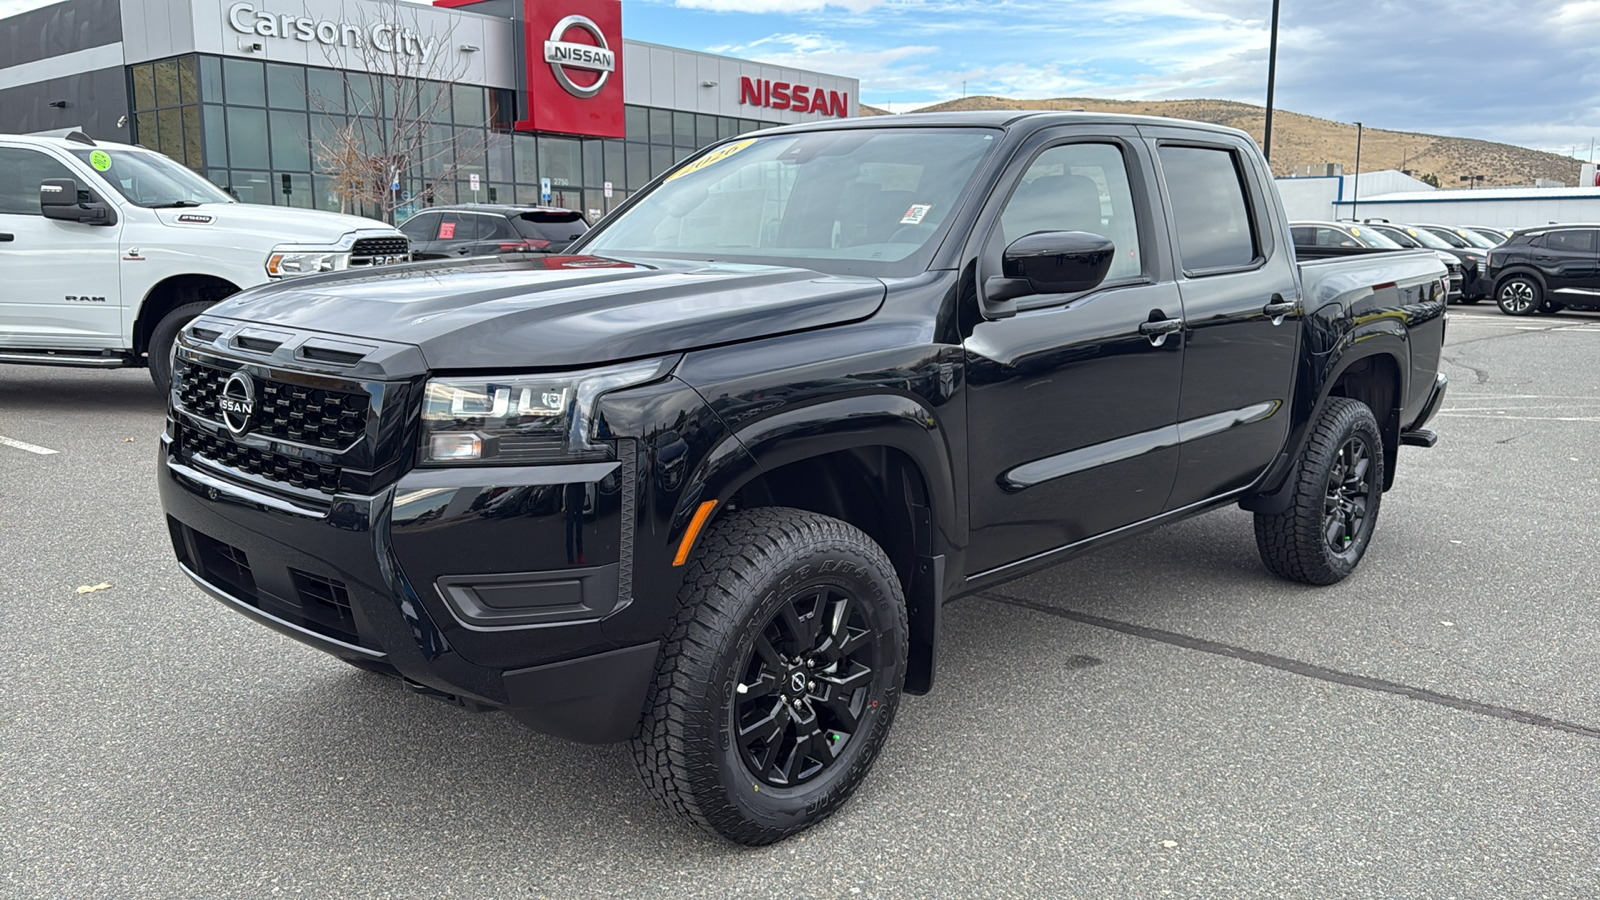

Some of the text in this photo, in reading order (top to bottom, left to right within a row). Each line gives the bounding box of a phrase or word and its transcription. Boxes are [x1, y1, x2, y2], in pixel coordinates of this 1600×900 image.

[229, 2, 435, 64] Carson City
[554, 46, 611, 67] NISSAN
[740, 76, 848, 118] NISSAN
[553, 178, 569, 186] 2750
[804, 686, 897, 816] YOKOHAMA
